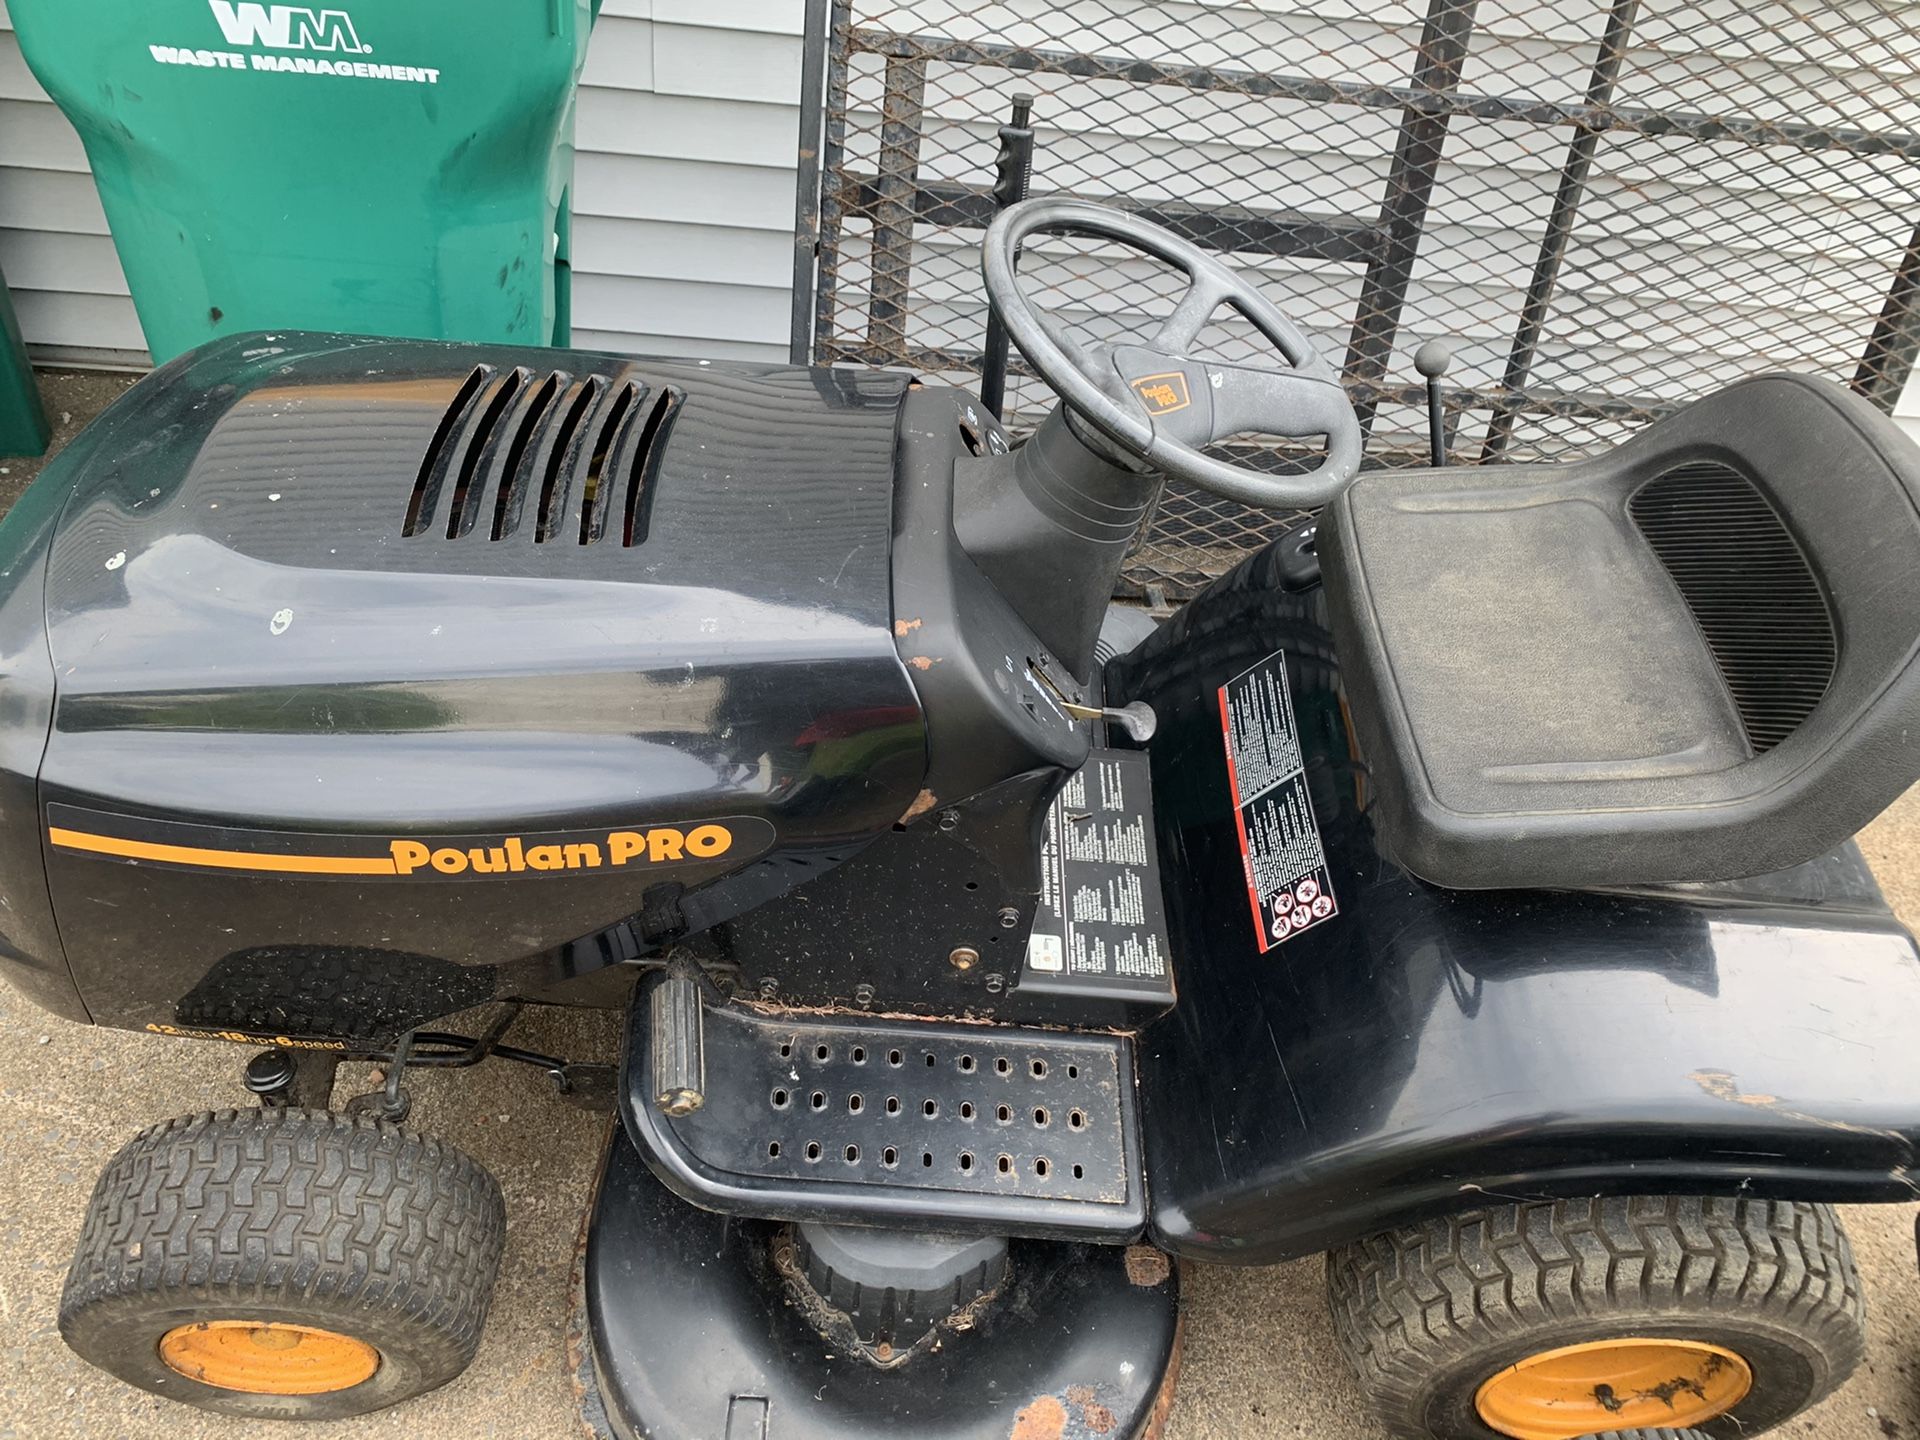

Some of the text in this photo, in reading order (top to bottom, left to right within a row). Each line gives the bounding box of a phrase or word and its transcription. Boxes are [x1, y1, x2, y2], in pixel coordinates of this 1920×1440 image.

[149, 45, 441, 83] WASTE MANAGEMENT
[389, 825, 732, 875] Poulan PRO
[1051, 856, 1060, 883] MANUEL
